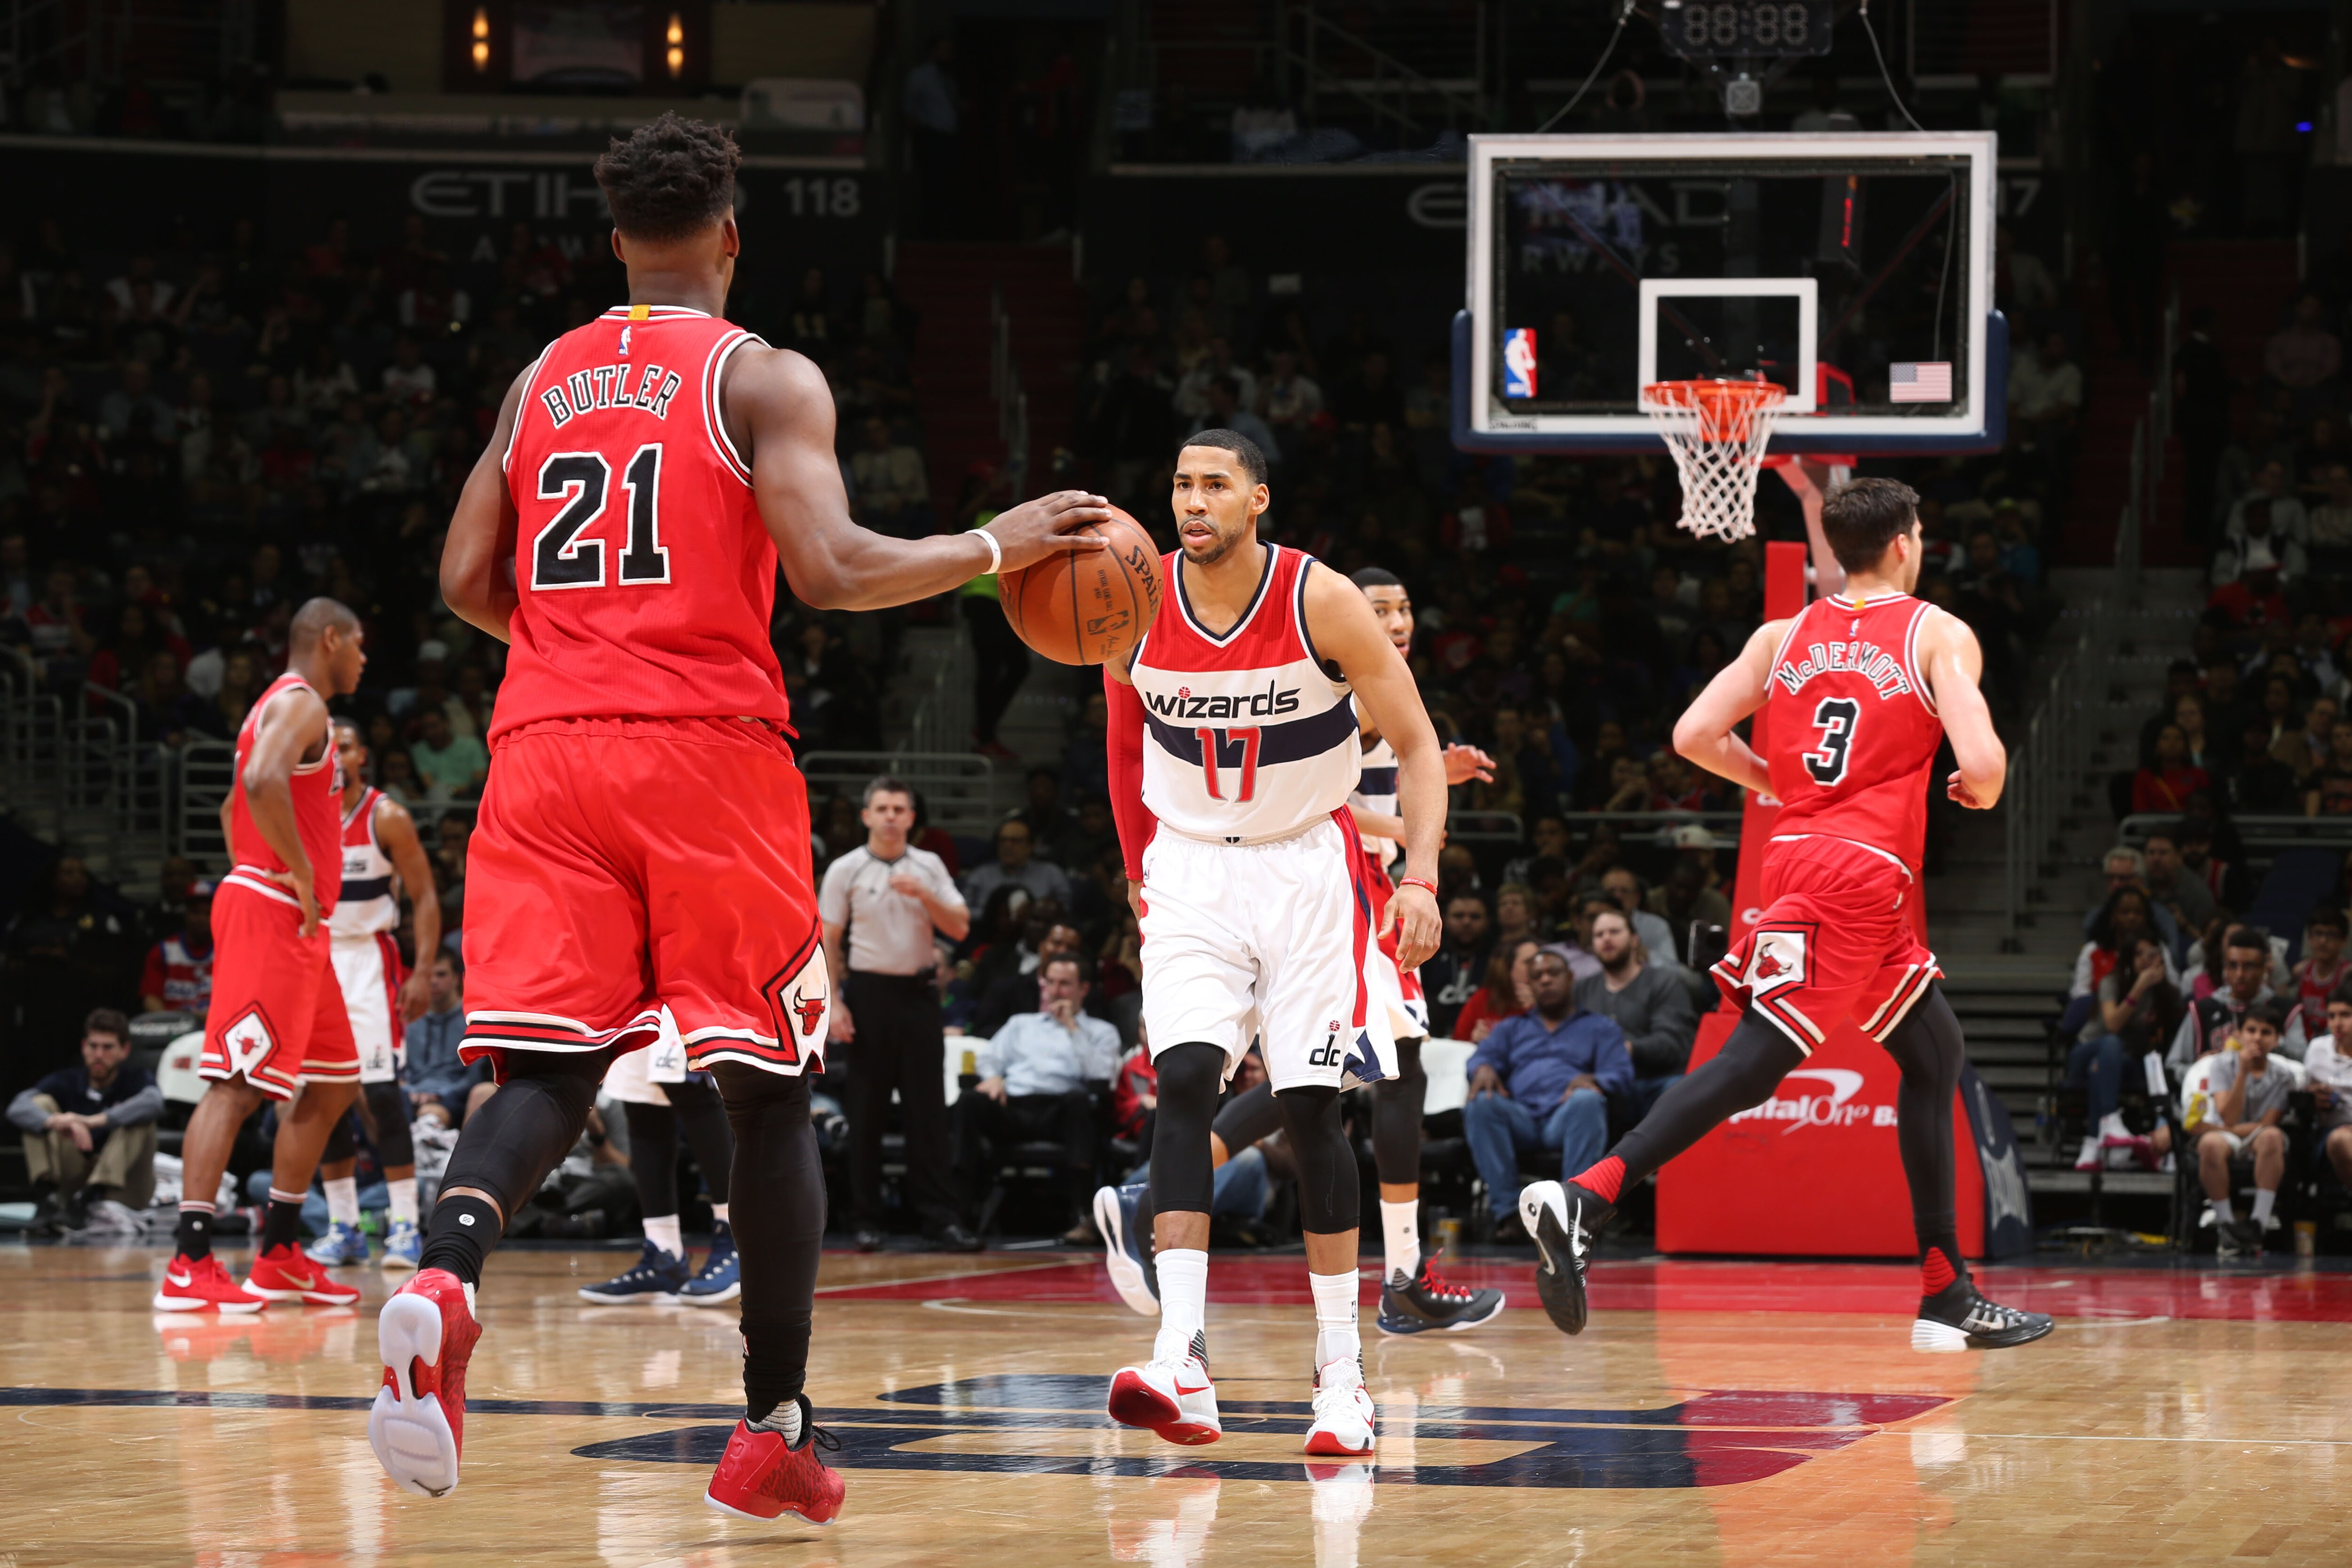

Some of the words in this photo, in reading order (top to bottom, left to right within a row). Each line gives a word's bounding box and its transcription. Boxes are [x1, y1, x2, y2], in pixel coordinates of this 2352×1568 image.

[784, 177, 860, 217] 118
[540, 364, 682, 430] BUTLER
[530, 442, 671, 591] 21
[1125, 545, 1158, 614] SPALD
[1145, 679, 1302, 719] wizards
[1775, 641, 1912, 700] McDERMOTT
[1195, 725, 1262, 803] 17
[1802, 696, 1861, 787] 3
[1309, 1032, 1341, 1067] dc
